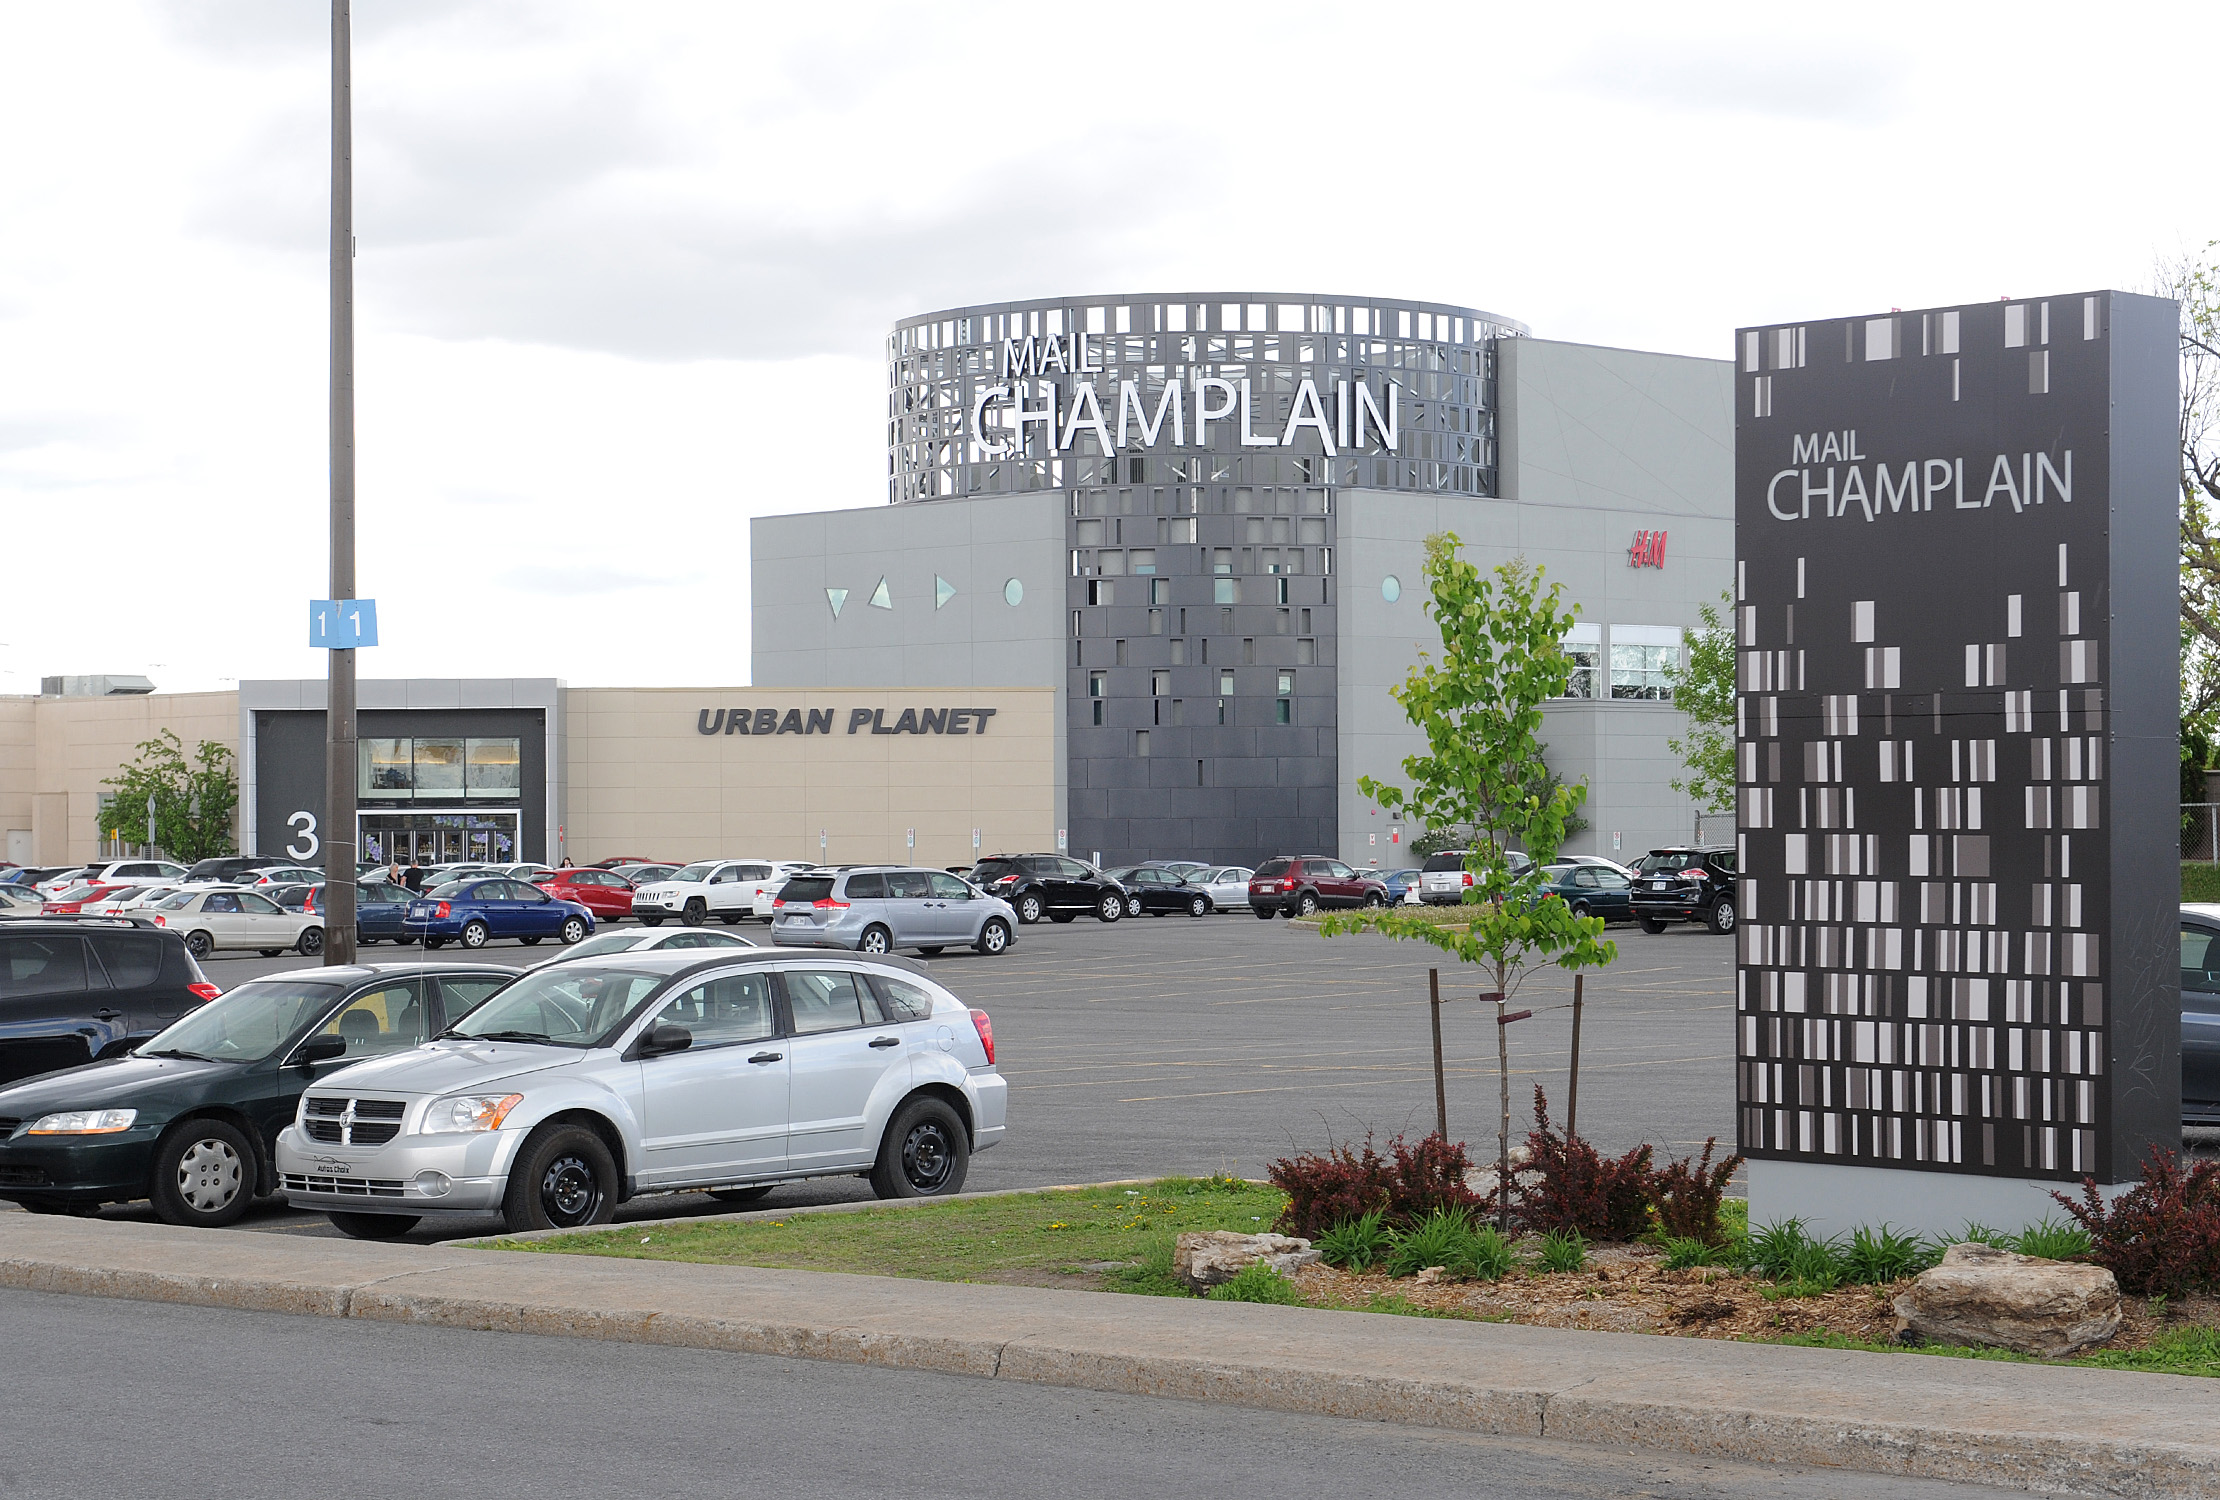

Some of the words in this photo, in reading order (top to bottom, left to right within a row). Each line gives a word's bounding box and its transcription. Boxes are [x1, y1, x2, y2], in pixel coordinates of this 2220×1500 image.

[1002, 332, 1103, 378] MAIL
[972, 377, 1398, 458] CHAMPLAIN
[1792, 429, 1866, 465] MAIL
[1766, 450, 2072, 522] CHAMPLAIN
[1628, 529, 1668, 570] H&M
[697, 707, 835, 736] URBAN
[847, 707, 997, 735] PLANET
[286, 810, 319, 861] 3
